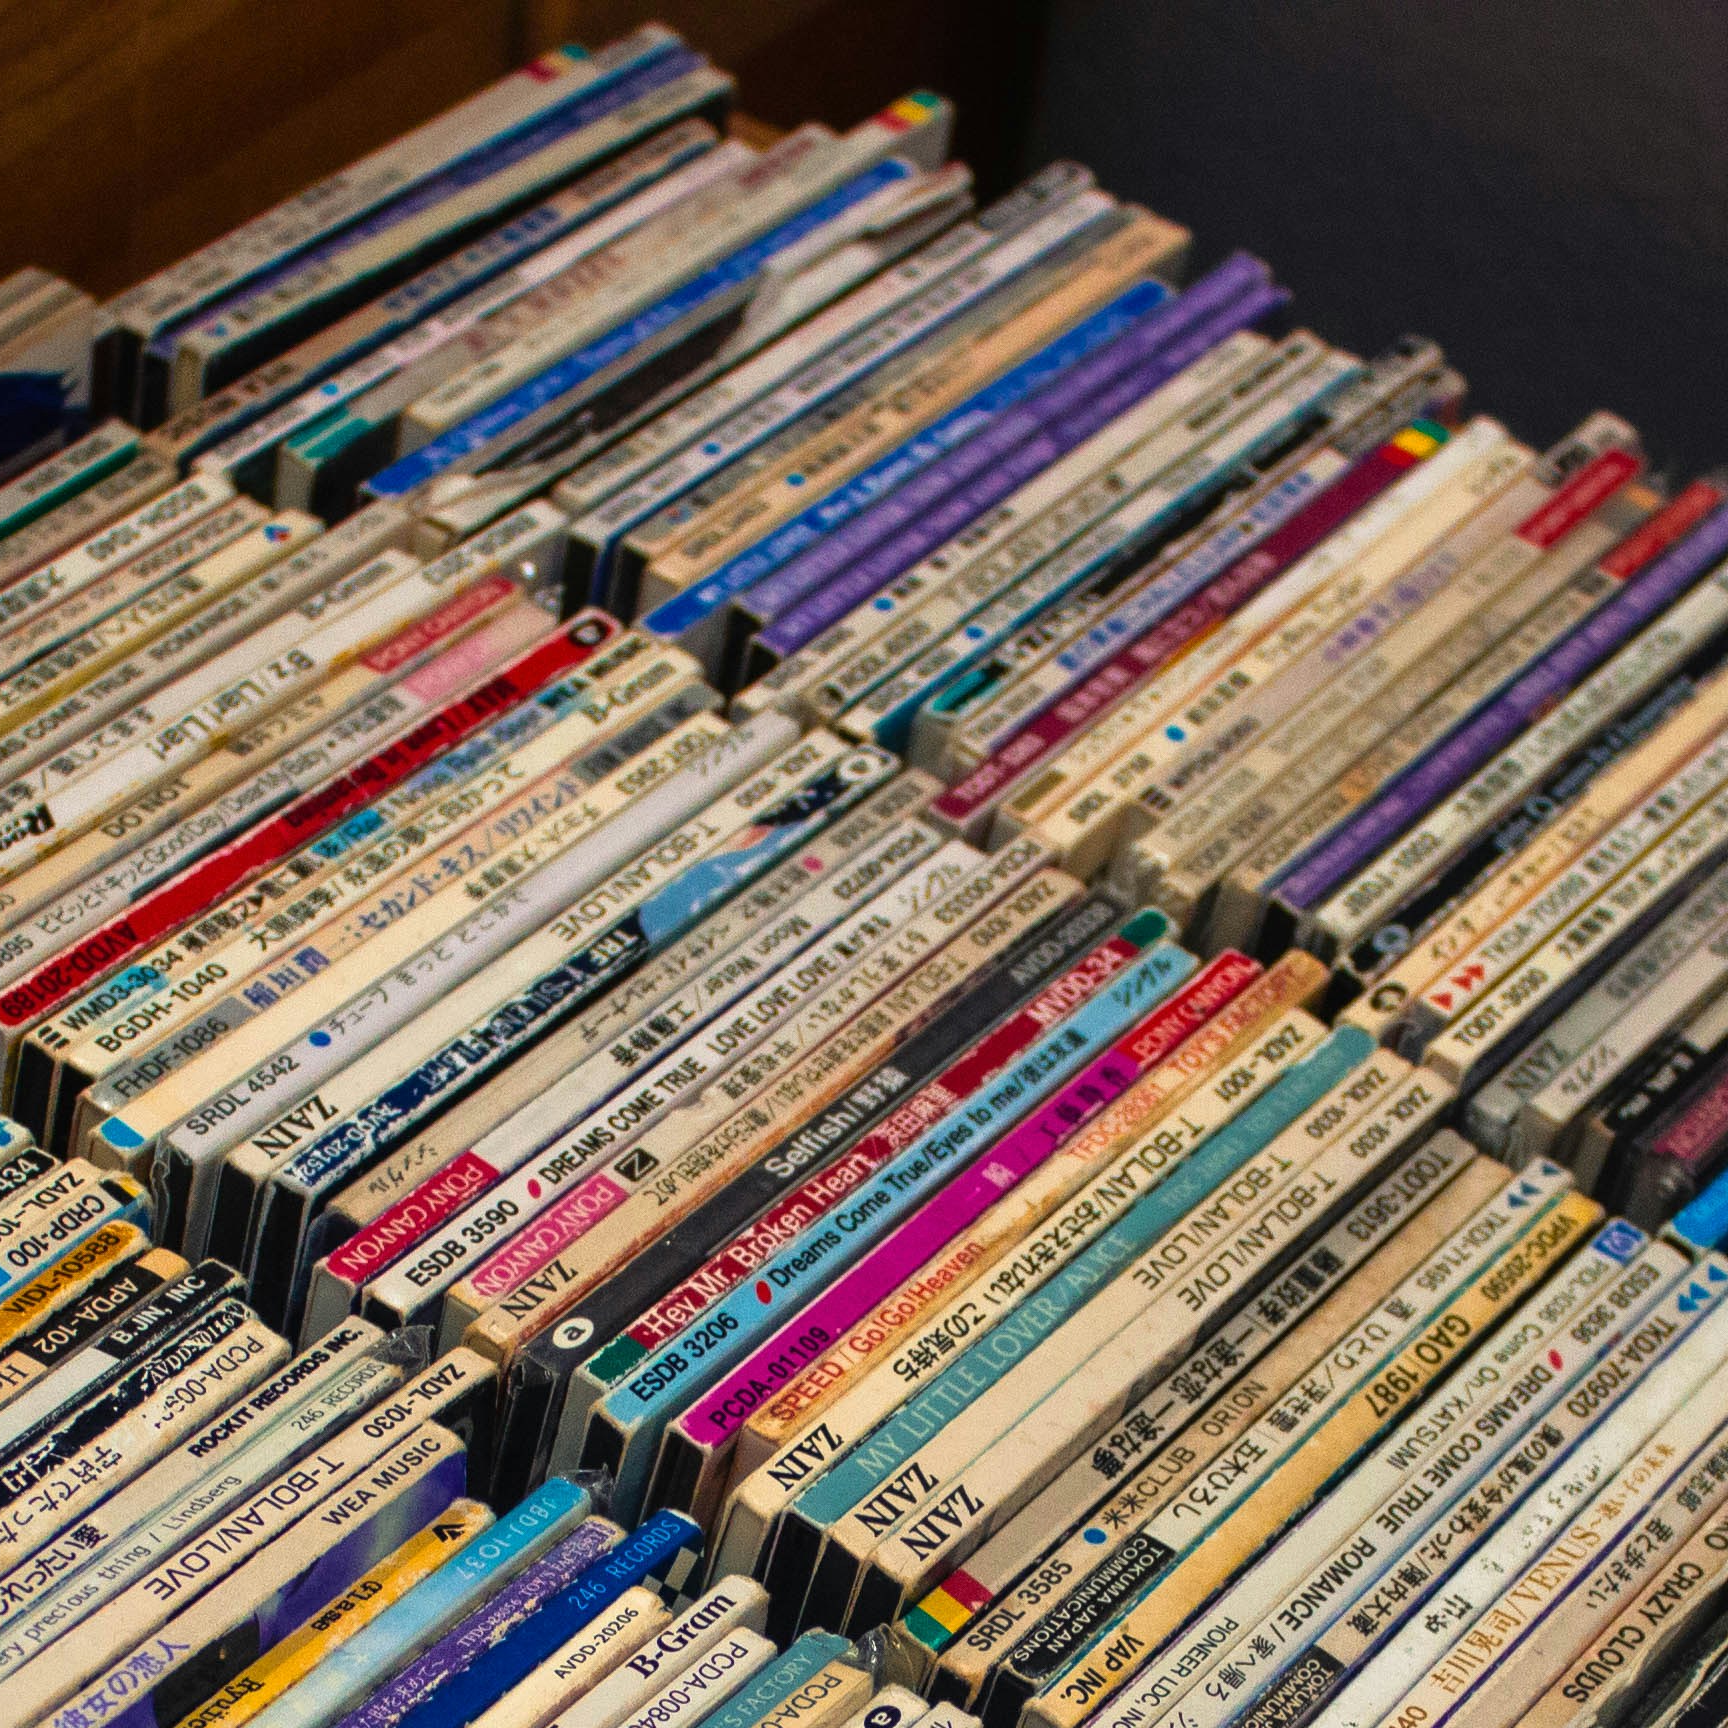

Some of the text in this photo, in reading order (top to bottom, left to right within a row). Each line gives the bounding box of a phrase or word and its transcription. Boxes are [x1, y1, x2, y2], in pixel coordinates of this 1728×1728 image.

[93, 961, 232, 1053] BGDH-1040
[184, 1053, 301, 1136] SRDL 4542
[248, 1095, 340, 1157] ZAIN
[402, 986, 802, 1287] ESDB 3590 DREAMS COME TRUE LOVE LOVE
[3, 1193, 110, 1268] CRDP-100
[339, 1162, 487, 1270] PONY CANYON
[725, 1149, 881, 1269] Broken Heart
[626, 1184, 895, 1404] ESDB 3206 Dreams Come
[1408, 1313, 1472, 1364] GAO
[186, 1349, 333, 1458] ROCKIT RECORDS
[763, 1357, 851, 1424] SPEED
[146, 1450, 345, 1601] T-BOLAN/LOVE
[159, 1471, 244, 1534] Lindberg
[320, 1485, 379, 1528] WEA
[368, 1434, 444, 1491] MUSIC
[895, 1484, 988, 1558] ZAIN
[962, 1379, 1270, 1654] SRDL 3585 ORION
[1271, 1535, 1380, 1629] ROMANCE
[549, 1605, 645, 1681] AVDD-20206
[625, 1589, 743, 1681] B-Gram
[1557, 1560, 1707, 1703] CRAZY CLOUDS
[733, 1651, 816, 1718] FACTORY
